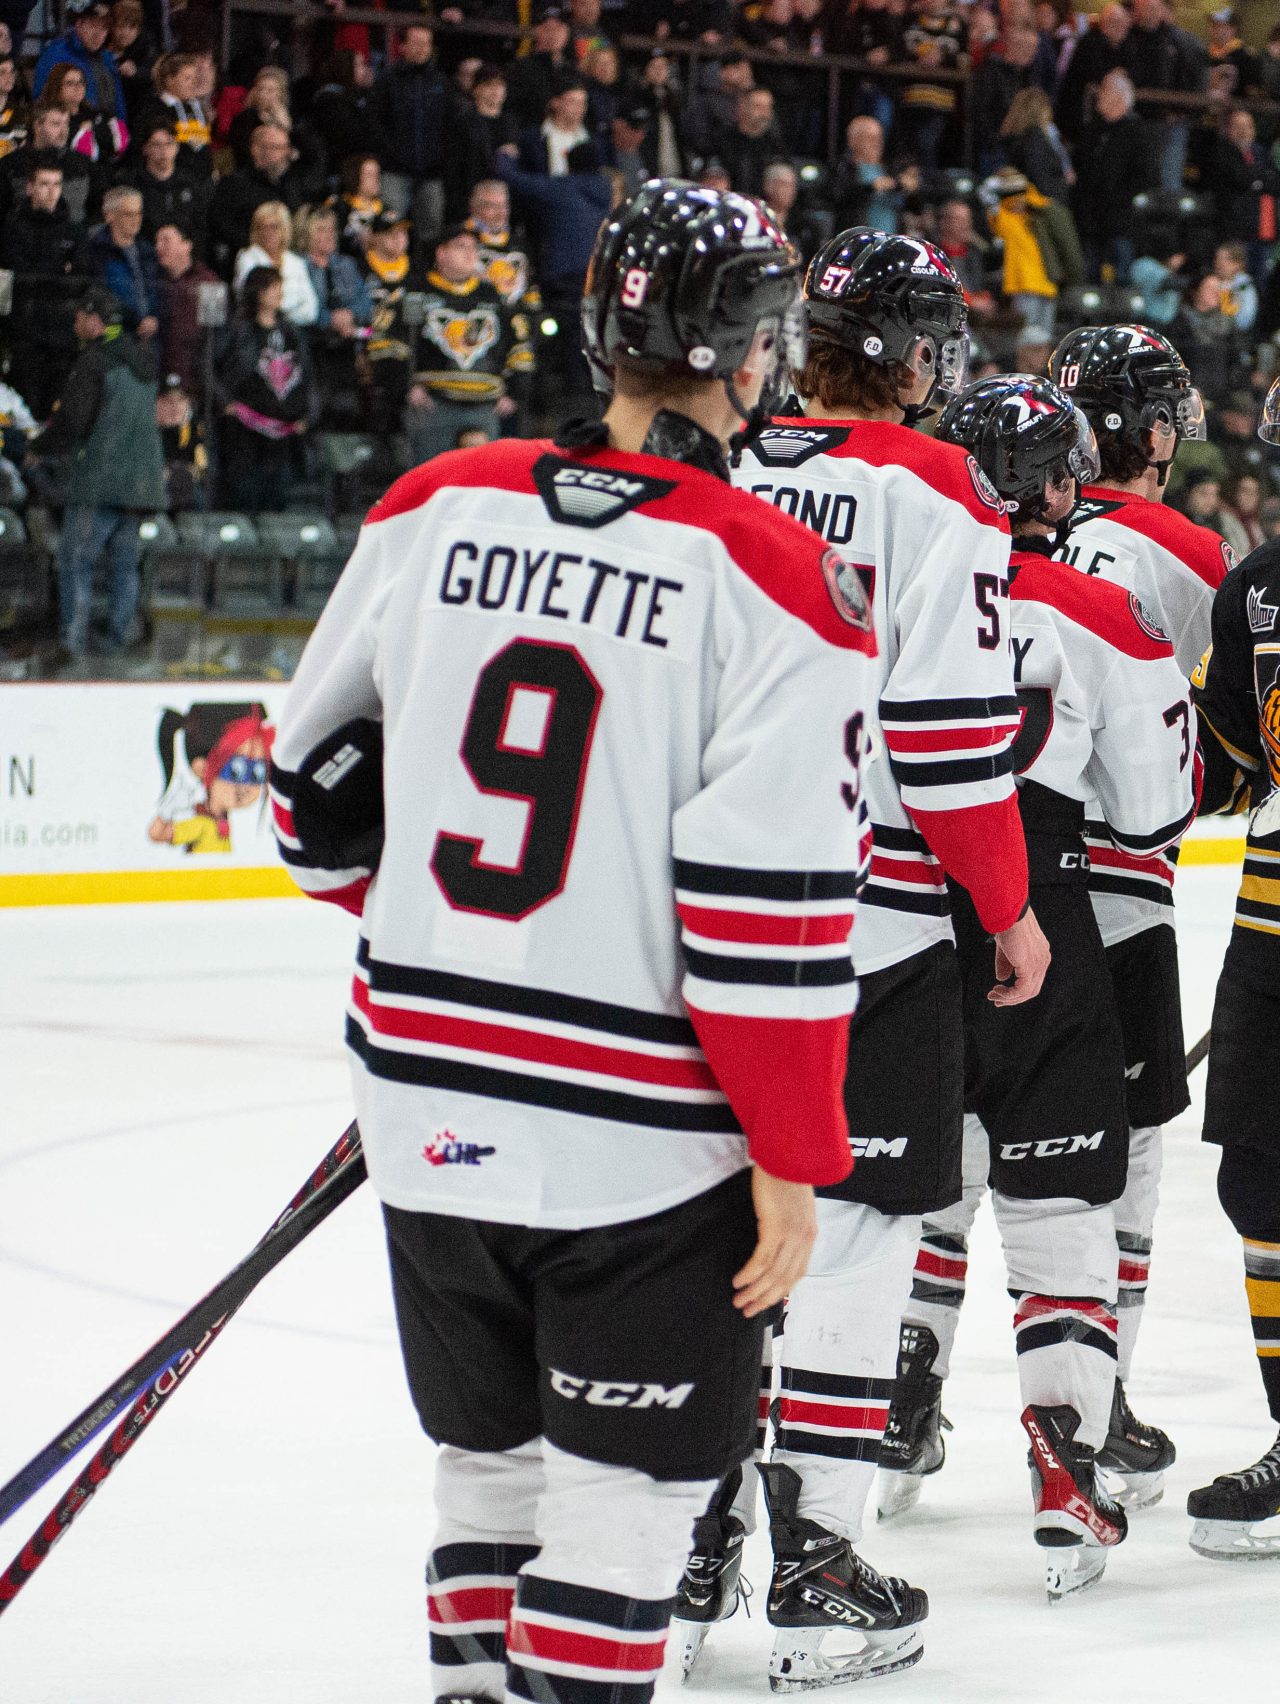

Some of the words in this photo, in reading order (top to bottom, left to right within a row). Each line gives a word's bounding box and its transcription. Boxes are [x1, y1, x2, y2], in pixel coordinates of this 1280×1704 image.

[622, 269, 648, 308] 9
[820, 266, 851, 293] 57
[864, 340, 880, 352] F.D.
[1060, 366, 1079, 389] 10
[759, 428, 829, 442] CCM
[554, 468, 645, 496] CCM
[439, 541, 684, 648] GOYETTE
[1162, 686, 1195, 774] 3
[429, 636, 605, 921] 9
[848, 1137, 908, 1158] CM
[1000, 1130, 1106, 1161] CCM
[548, 1366, 696, 1409] CCM
[1027, 1420, 1060, 1470] CCM
[1065, 1494, 1121, 1545] CCM
[686, 1556, 723, 1571] 57
[801, 1587, 861, 1624] CCM
[897, 1631, 917, 1650] CCM
